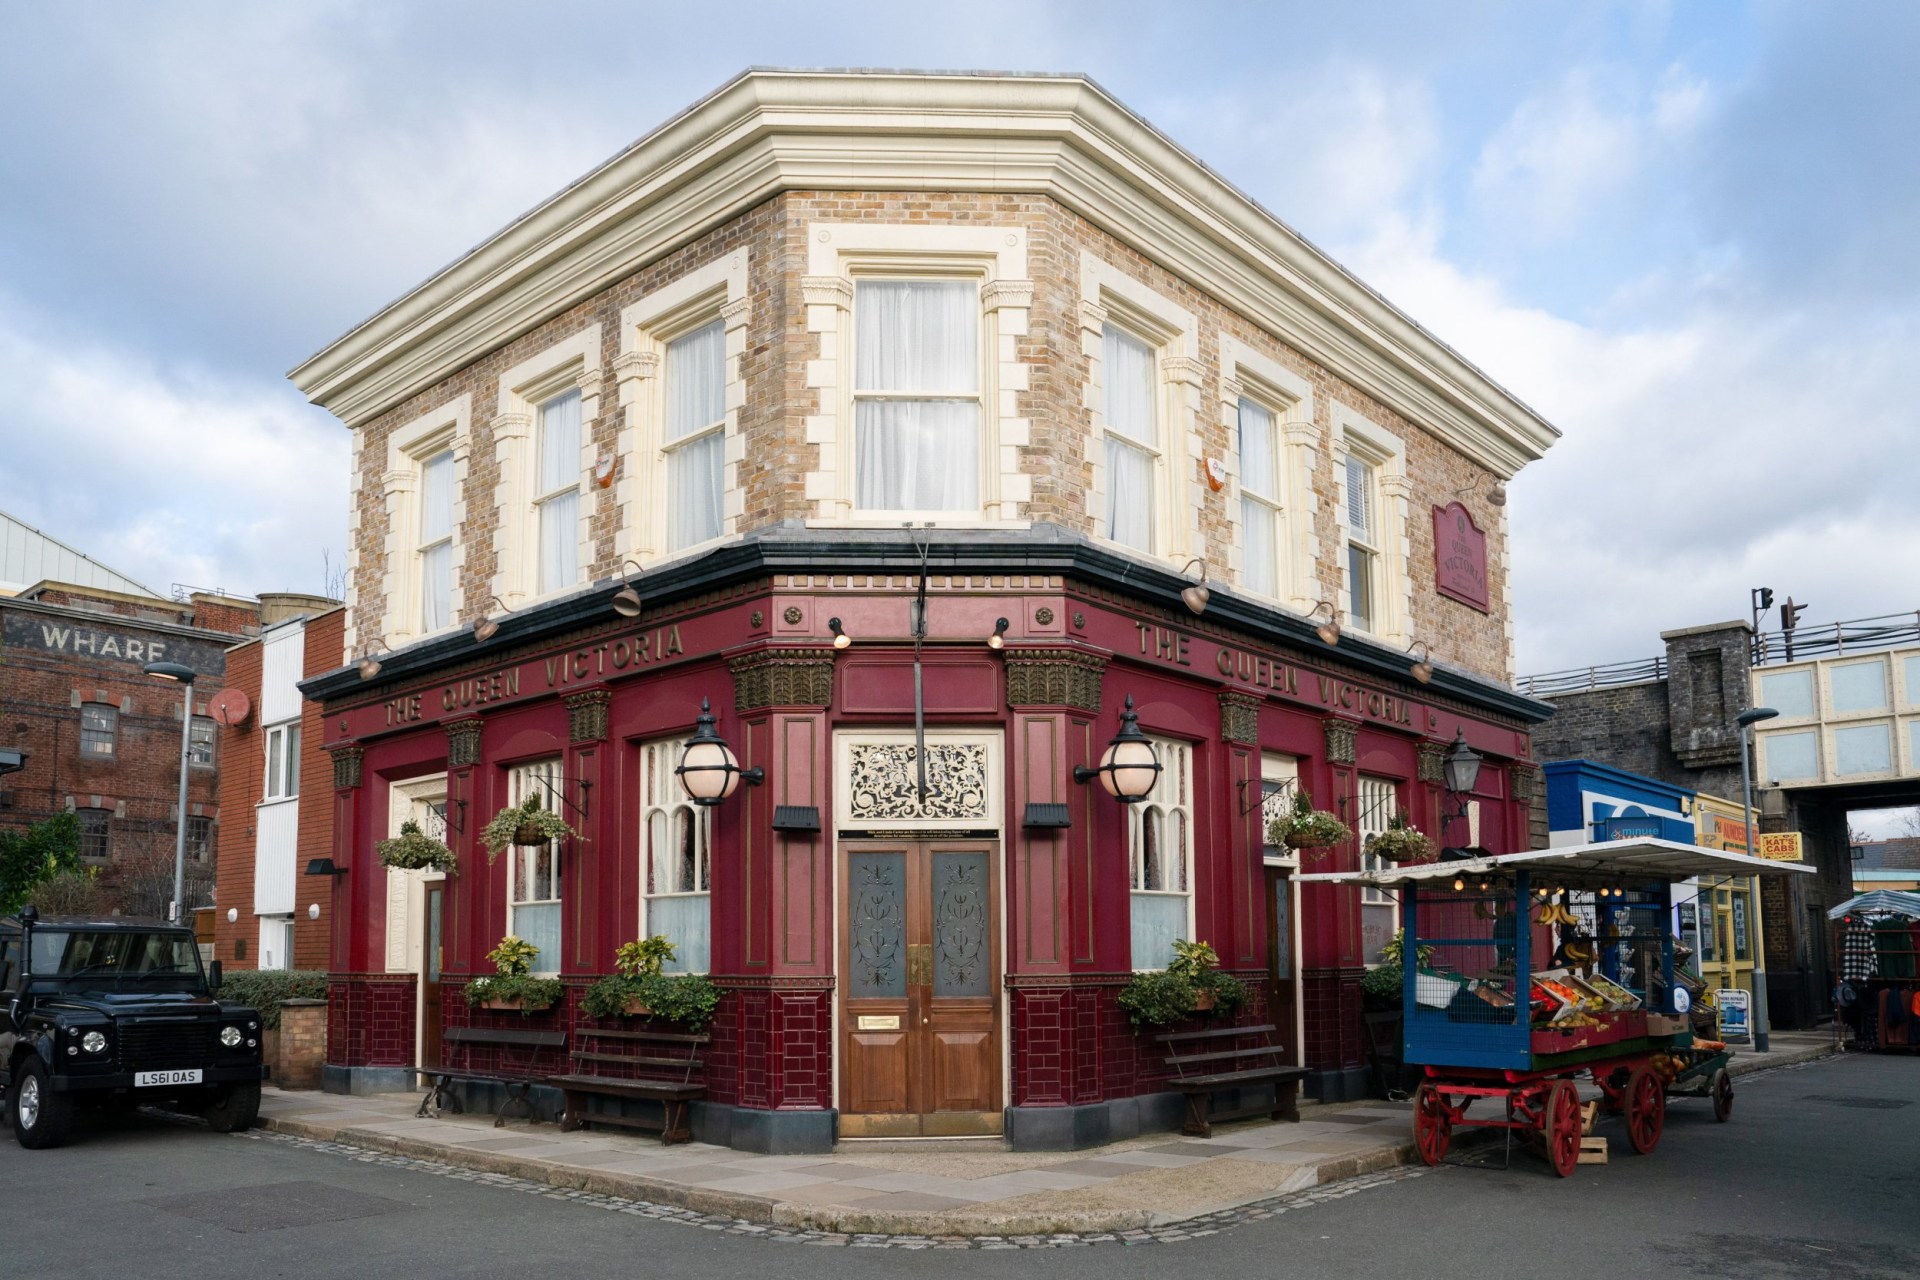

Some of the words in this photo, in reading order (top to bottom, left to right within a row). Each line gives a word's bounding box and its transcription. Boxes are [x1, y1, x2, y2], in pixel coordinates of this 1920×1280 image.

[1444, 556, 1483, 589] VICTORIA
[41, 625, 166, 662] WHARF
[383, 693, 422, 726] THE
[442, 667, 520, 712] QUEEN
[545, 624, 684, 686] VICTORIA
[1135, 620, 1191, 666] THE
[1216, 649, 1298, 695] QUEEN
[1317, 674, 1411, 726] VICTORIA
[1622, 827, 1660, 836] minute
[1766, 844, 1794, 852] CABS
[142, 1073, 169, 1085] LS61
